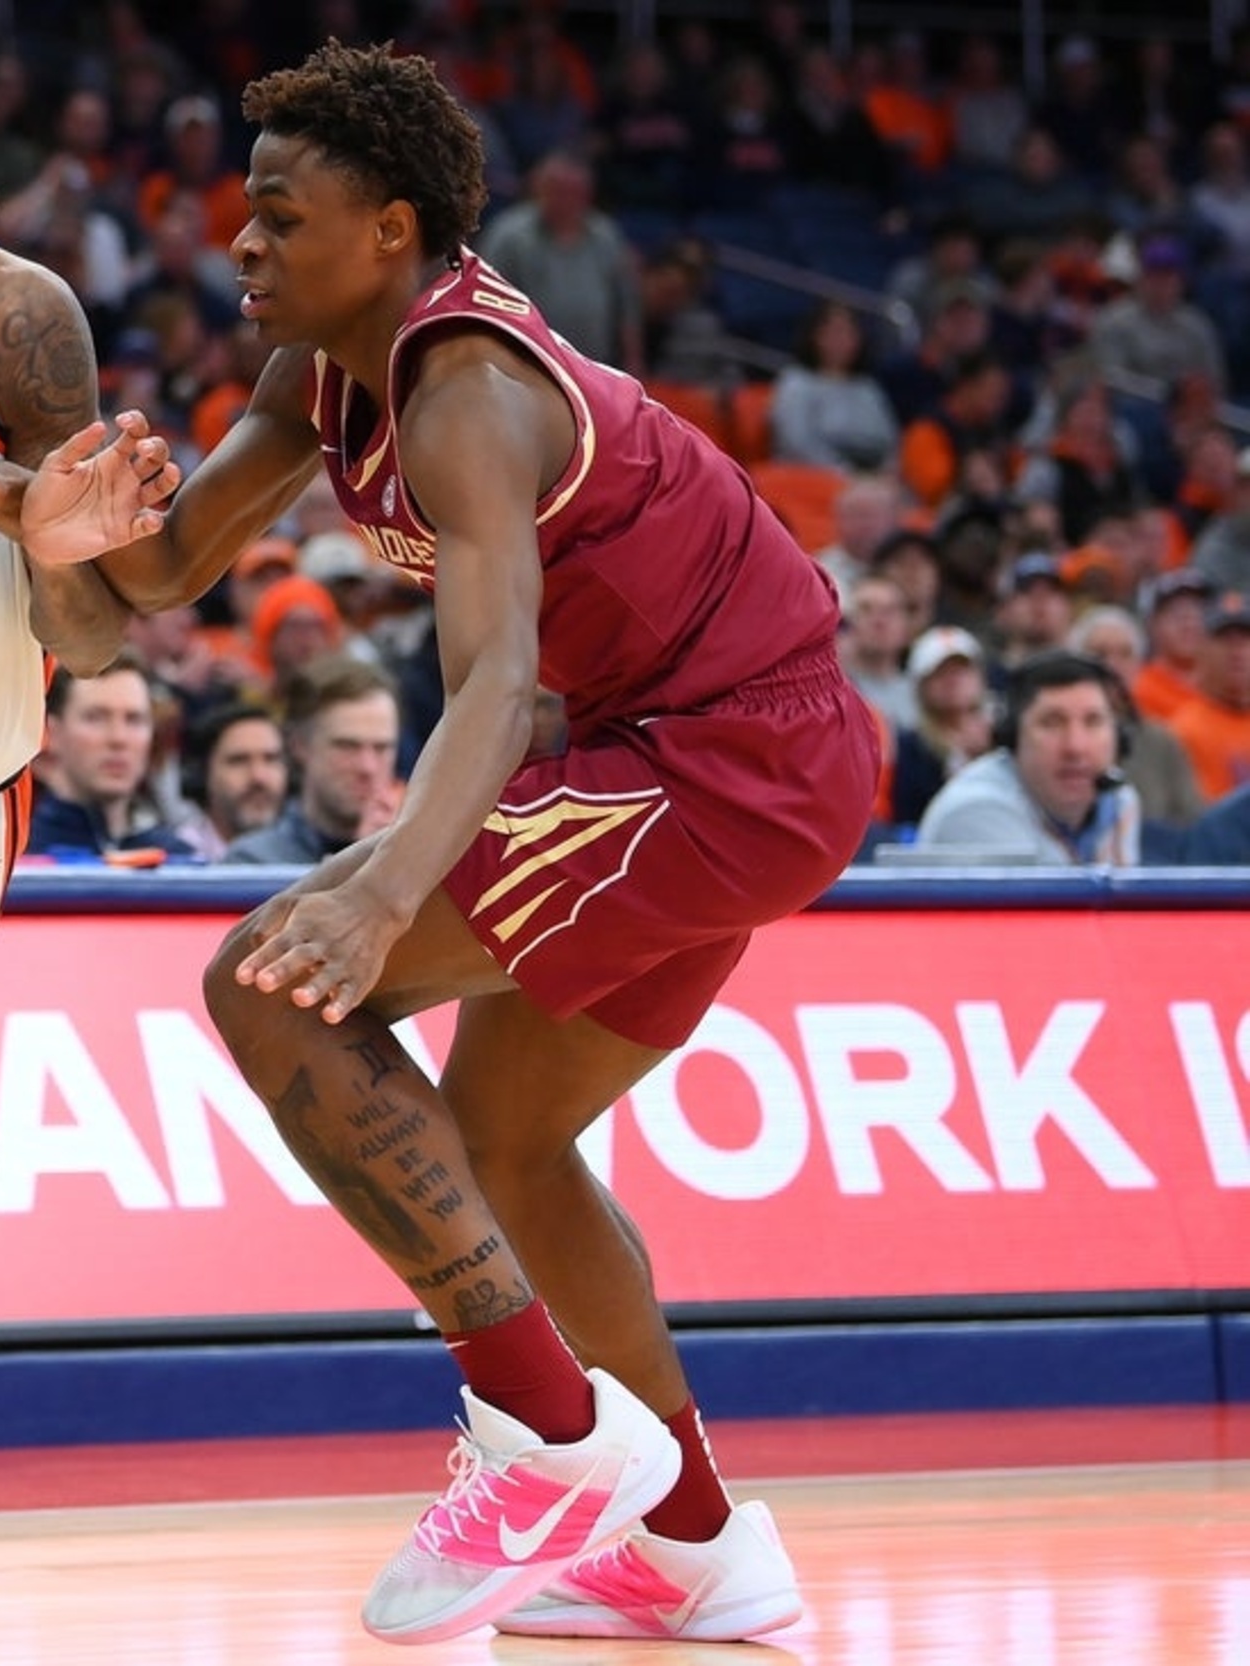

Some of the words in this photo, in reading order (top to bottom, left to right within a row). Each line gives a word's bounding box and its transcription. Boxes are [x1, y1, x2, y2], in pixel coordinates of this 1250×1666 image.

[346, 1095, 400, 1129] WILL
[390, 998, 1159, 1202] ORK
[1167, 999, 1250, 1191] I
[356, 1109, 427, 1162] ALWAYS
[395, 1146, 424, 1173] BE
[400, 1160, 449, 1201] WITH
[426, 1186, 463, 1221] YOU
